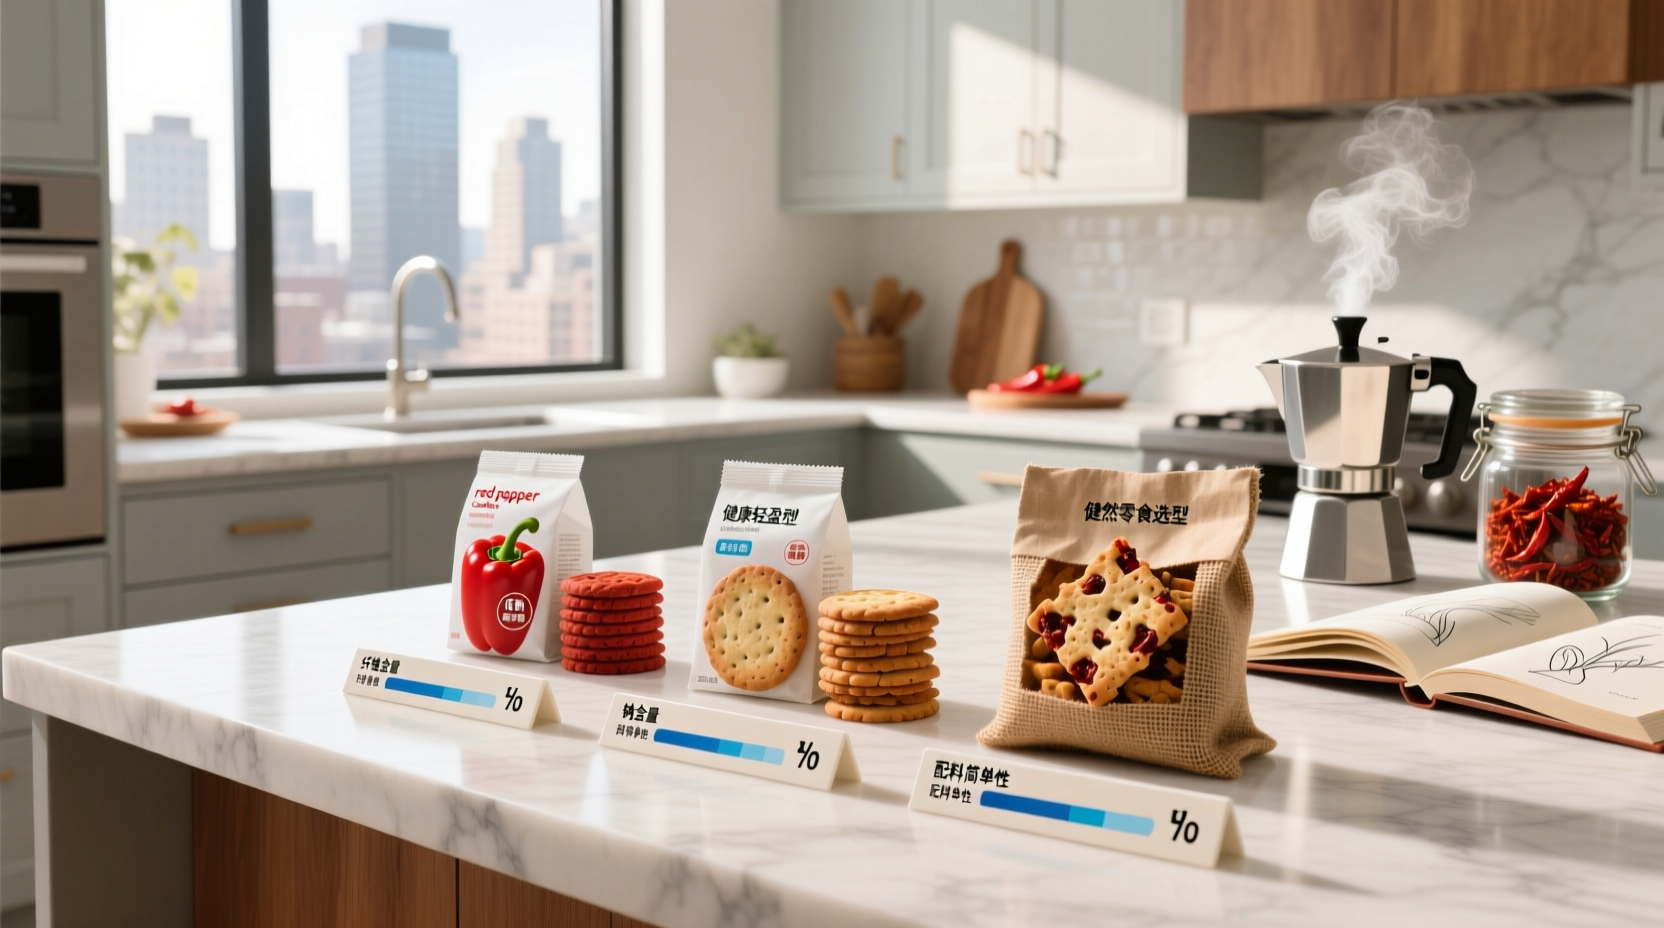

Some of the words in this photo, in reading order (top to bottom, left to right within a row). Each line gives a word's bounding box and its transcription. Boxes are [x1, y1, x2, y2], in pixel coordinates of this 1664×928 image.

[934, 760, 1010, 788] 配料简单性
